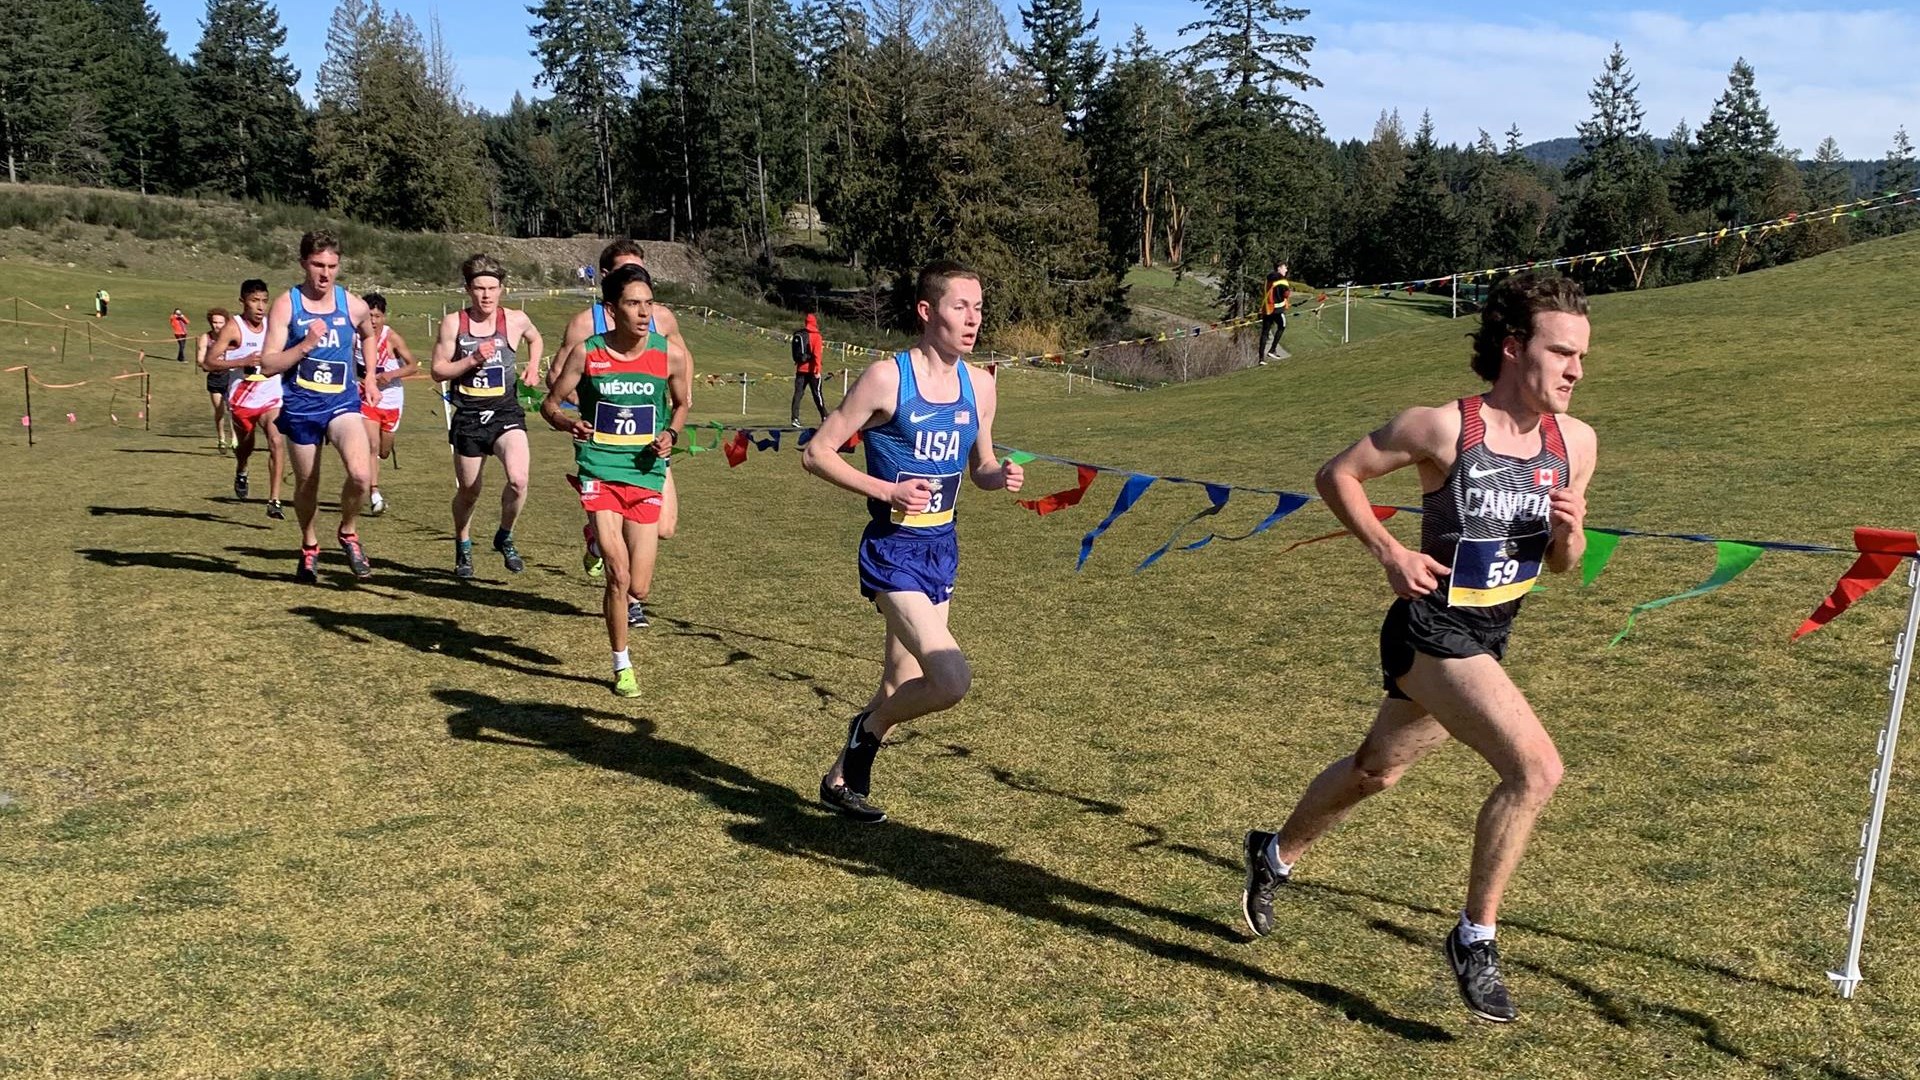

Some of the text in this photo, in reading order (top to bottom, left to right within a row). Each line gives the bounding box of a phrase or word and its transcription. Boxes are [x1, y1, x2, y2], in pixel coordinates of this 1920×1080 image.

[305, 329, 340, 348] SA
[313, 370, 333, 384] 68
[473, 377, 490, 388] 61
[600, 380, 655, 395] MÉXICO
[614, 419, 636, 435] 70
[914, 430, 960, 461] USA
[1486, 559, 1520, 588] 59
